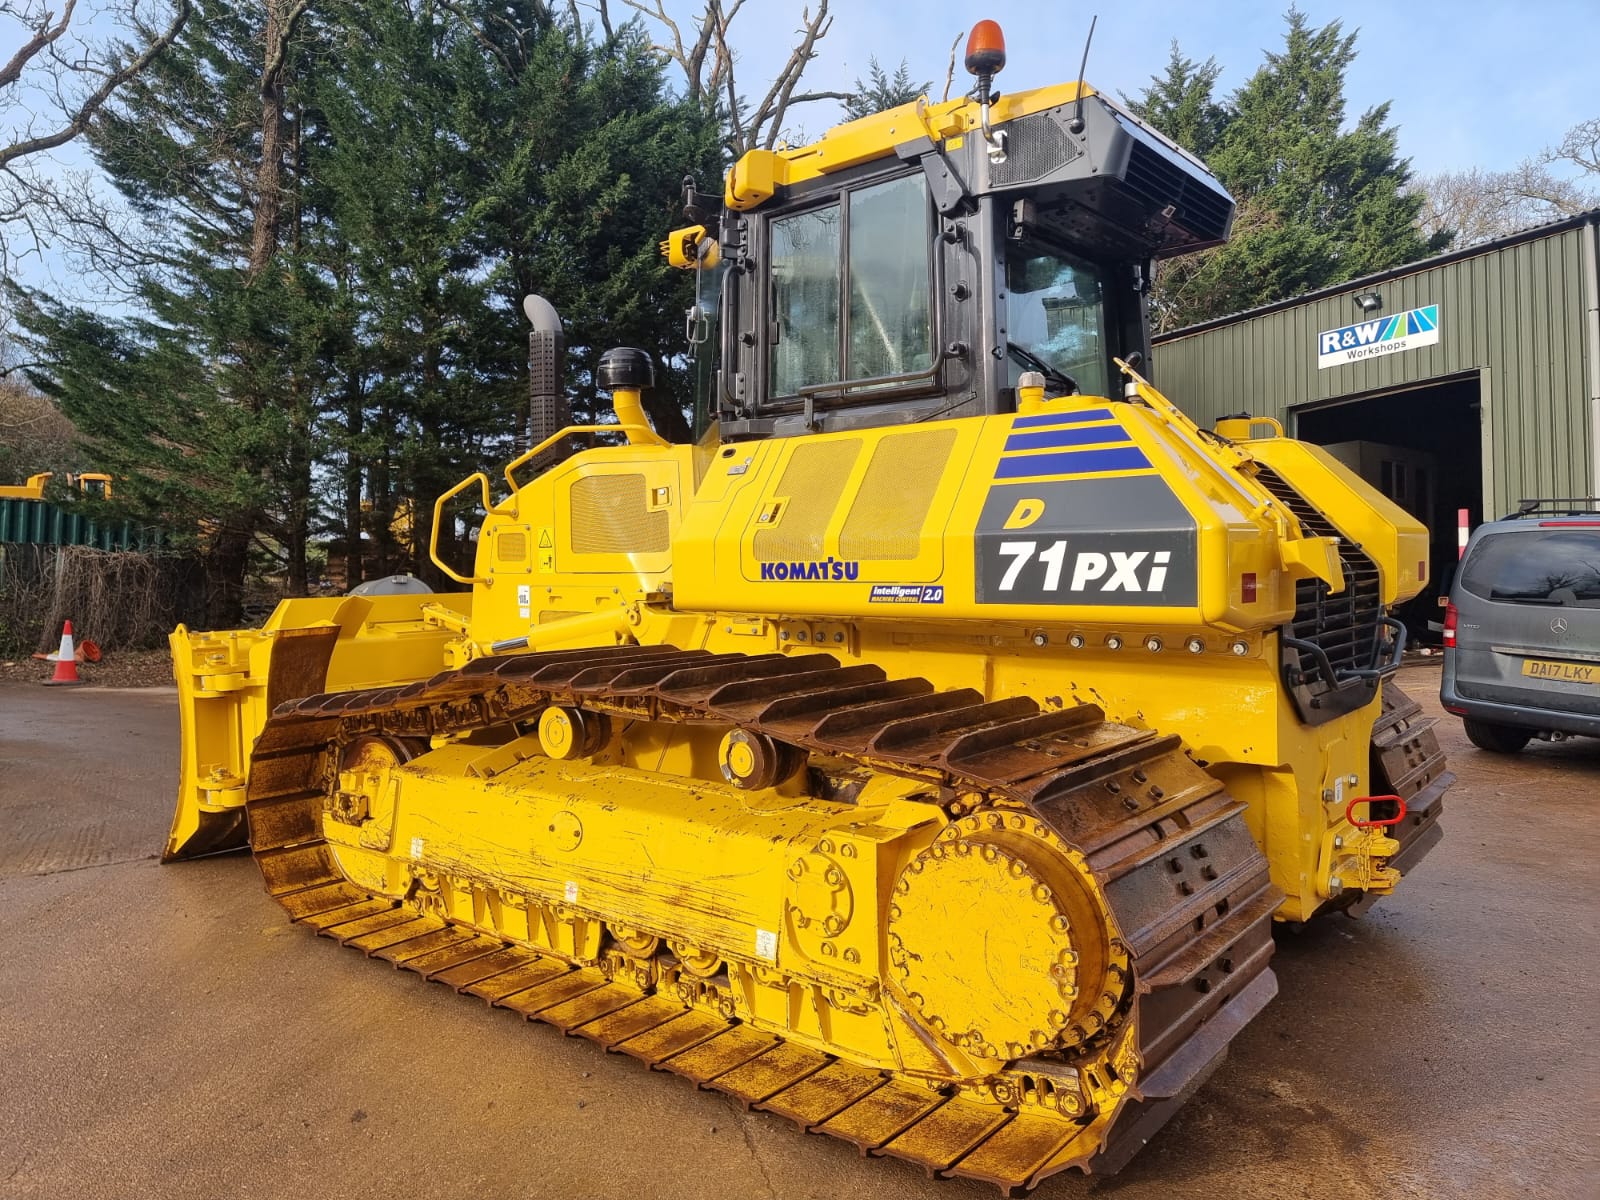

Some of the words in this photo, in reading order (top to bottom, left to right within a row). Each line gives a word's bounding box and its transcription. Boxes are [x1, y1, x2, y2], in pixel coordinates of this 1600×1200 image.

[1322, 321, 1380, 354] R&W
[1346, 340, 1407, 360] Workshops
[1003, 498, 1045, 530] D
[761, 556, 859, 581] KOMATSU
[923, 588, 943, 601] 2.0
[1530, 662, 1562, 678] DA17
[1564, 666, 1593, 680] LKY
